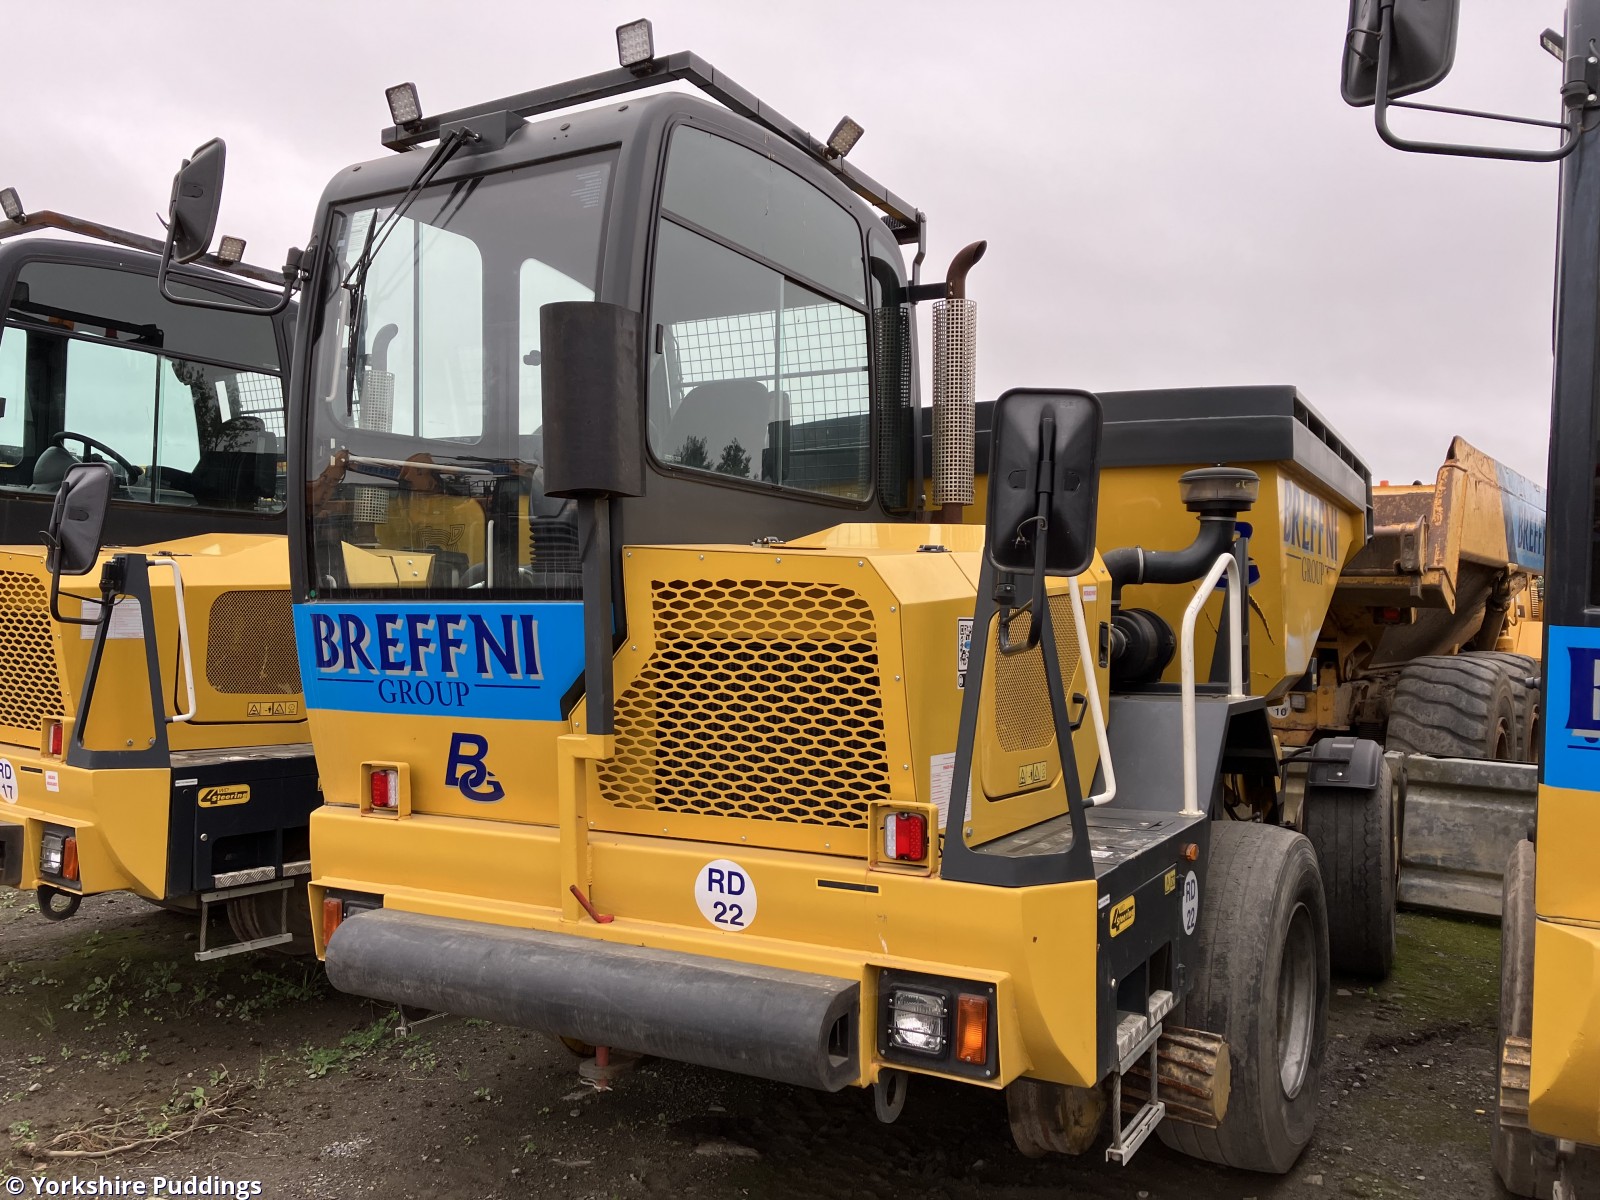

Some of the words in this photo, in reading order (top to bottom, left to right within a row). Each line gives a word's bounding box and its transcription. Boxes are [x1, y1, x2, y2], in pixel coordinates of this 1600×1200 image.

[1283, 480, 1338, 562] BREFFNI
[1302, 557, 1324, 585] GROUP
[309, 614, 544, 680] BREFFNI
[378, 679, 470, 707] GROUP
[1275, 708, 1287, 716] 10
[2, 784, 13, 800] 17
[708, 867, 746, 896] RD
[1185, 879, 1196, 903] RD
[713, 901, 744, 927] 22
[1186, 907, 1195, 931] 22
